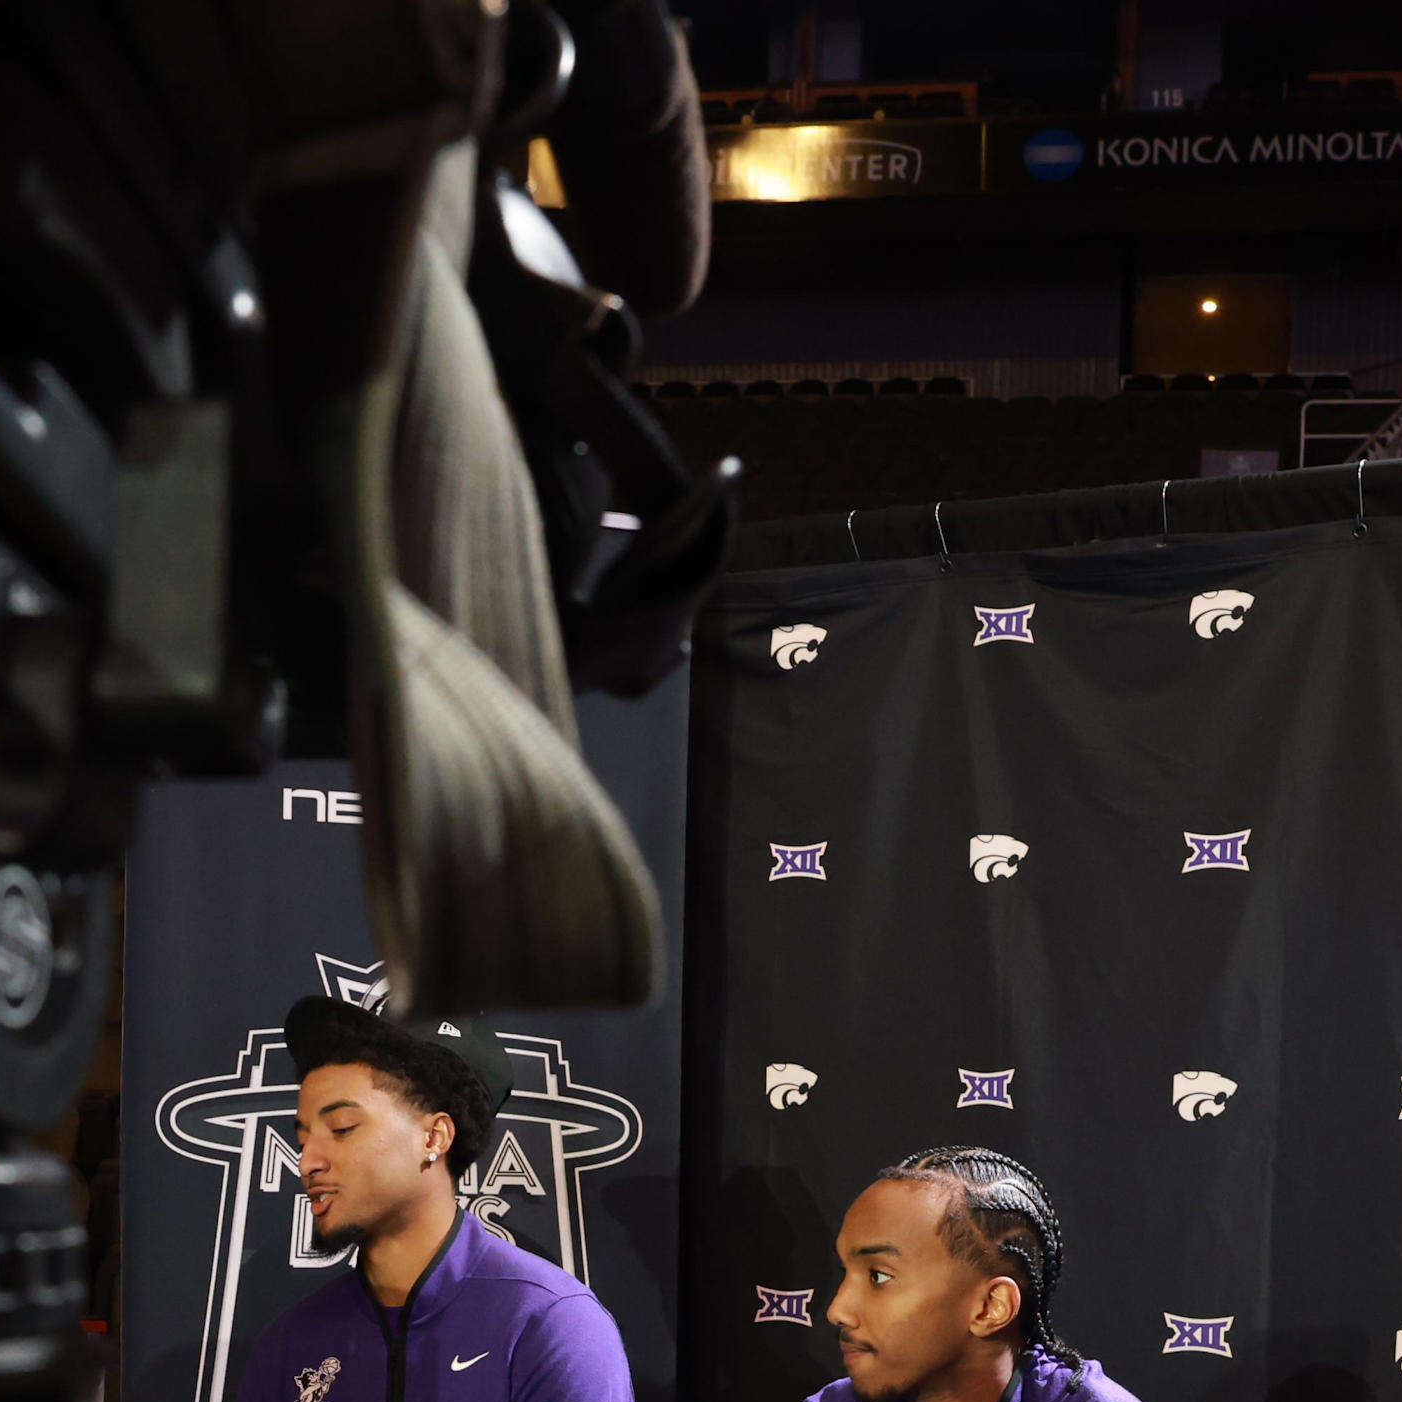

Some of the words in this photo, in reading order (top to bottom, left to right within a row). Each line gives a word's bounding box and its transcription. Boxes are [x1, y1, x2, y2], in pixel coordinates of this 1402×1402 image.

[1151, 88, 1184, 108] 115
[1097, 135, 1239, 168] KONICA
[801, 153, 909, 182] ENTER
